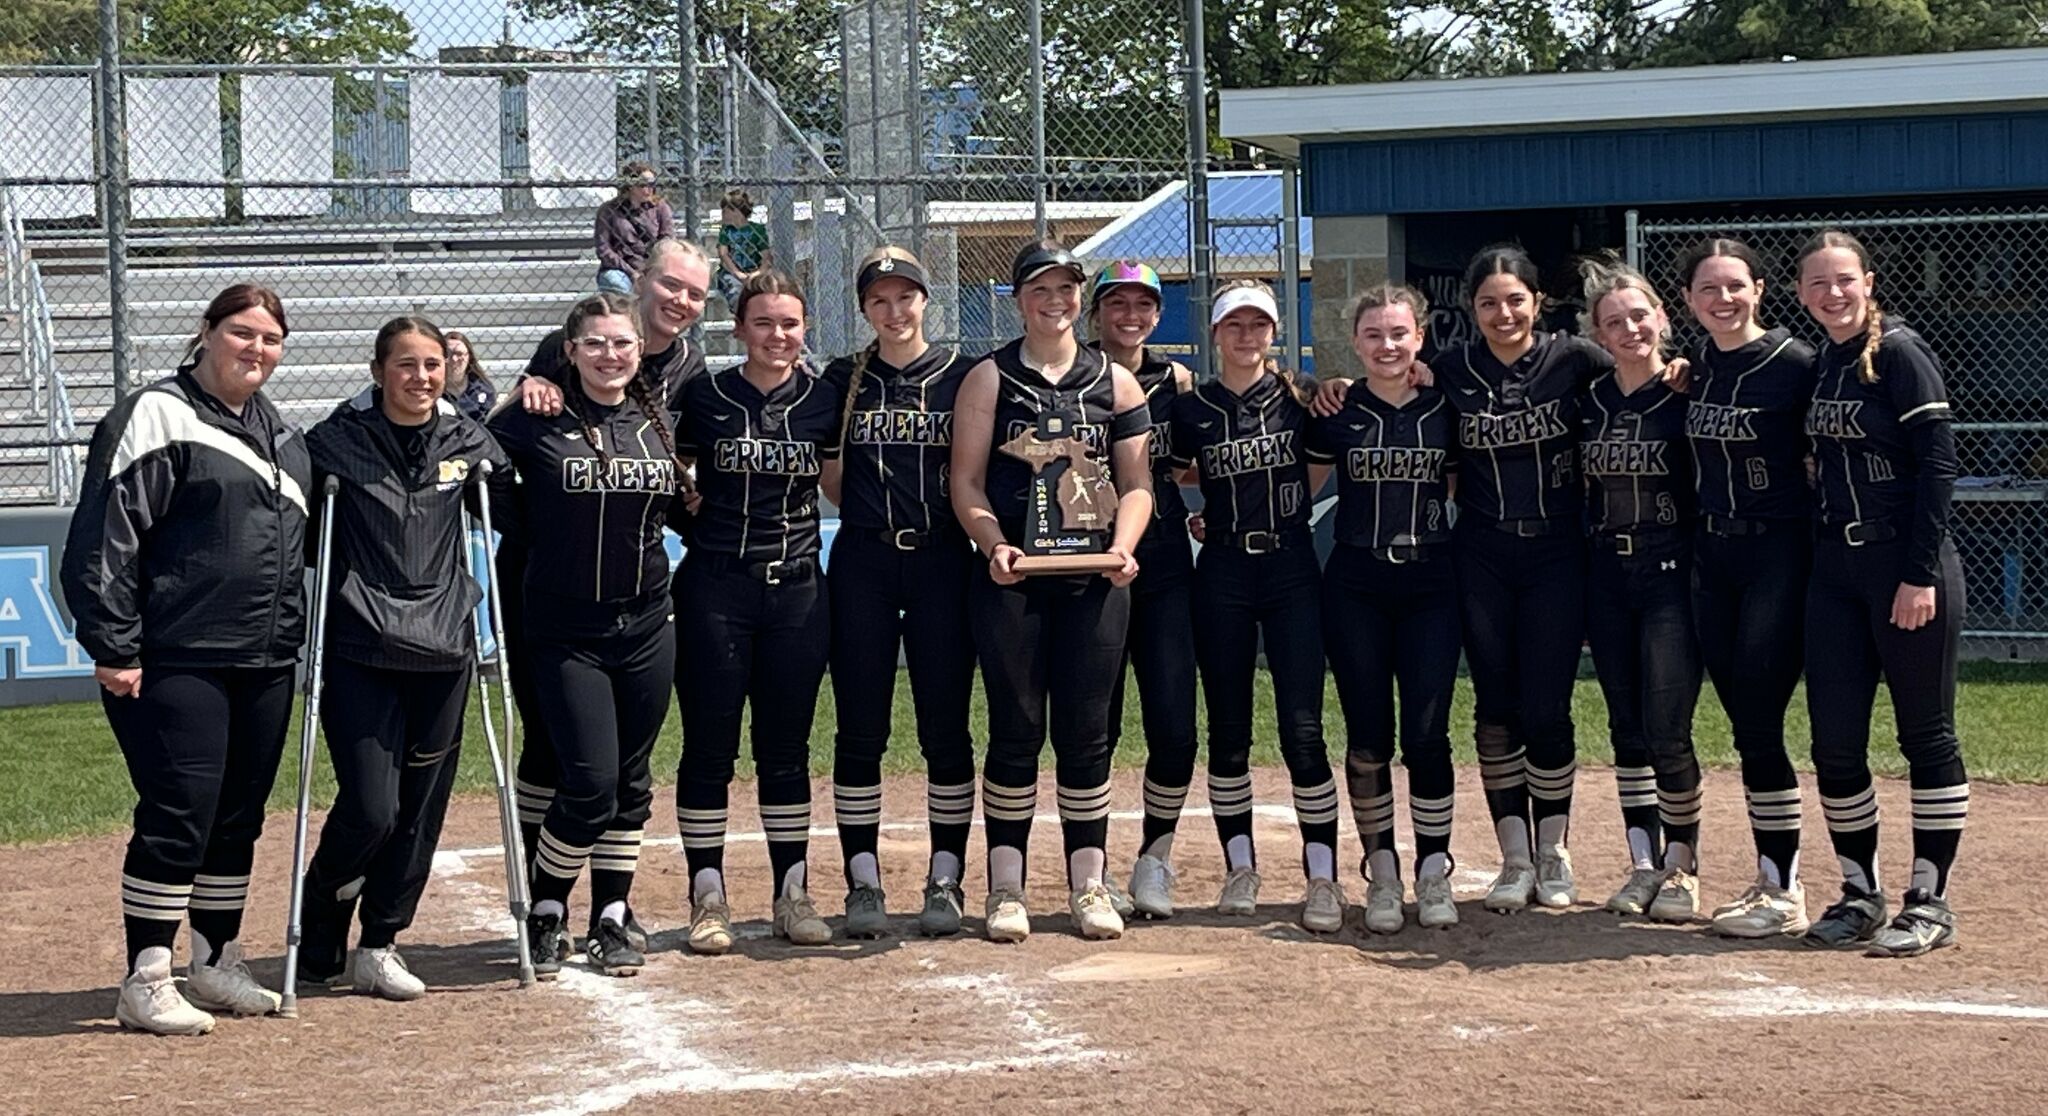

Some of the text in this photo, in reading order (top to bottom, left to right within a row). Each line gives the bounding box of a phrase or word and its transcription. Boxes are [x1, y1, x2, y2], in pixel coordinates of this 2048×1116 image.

[849, 408, 953, 446] CREEK
[1460, 399, 1568, 449] CREEK
[714, 438, 820, 476] CREEK
[1202, 430, 1297, 479] CREEK
[1347, 447, 1446, 483] CREEK
[1745, 456, 1769, 490] 6
